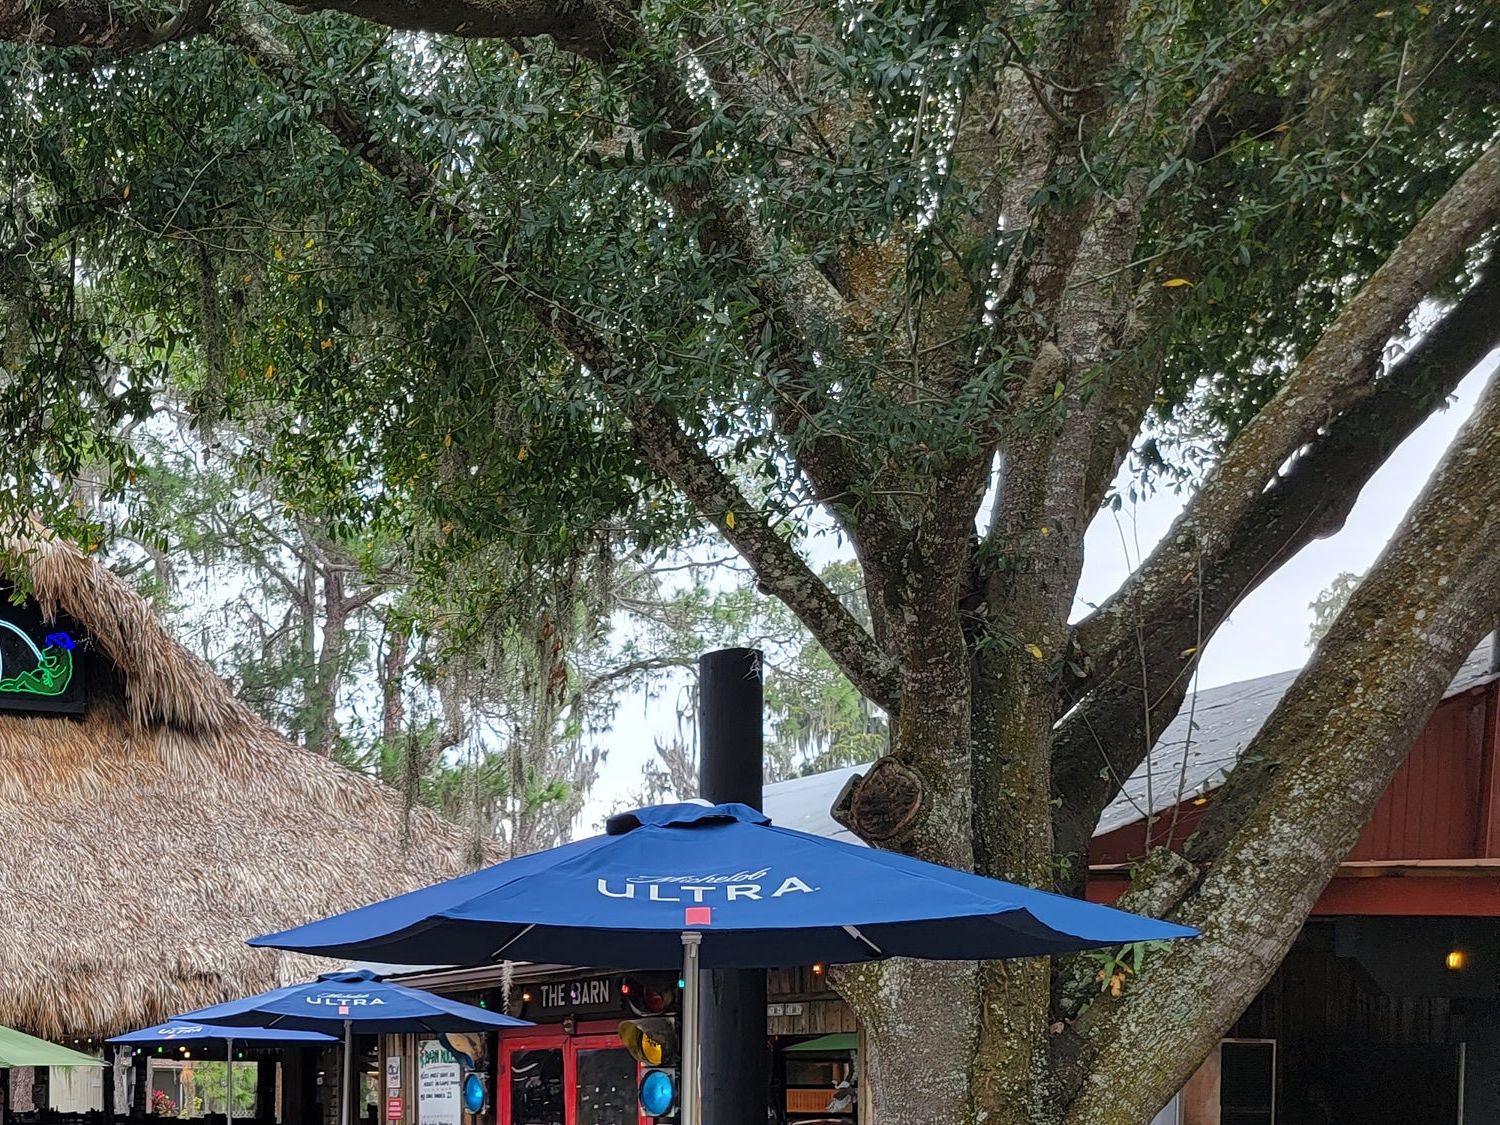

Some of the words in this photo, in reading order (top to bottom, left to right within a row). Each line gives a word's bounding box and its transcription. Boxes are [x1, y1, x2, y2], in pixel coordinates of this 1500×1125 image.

[626, 867, 772, 884] Michelob
[597, 876, 814, 902] ULTRA
[306, 996, 386, 1006] ULTRA
[540, 983, 565, 1007] THE
[572, 980, 609, 1005] BARN
